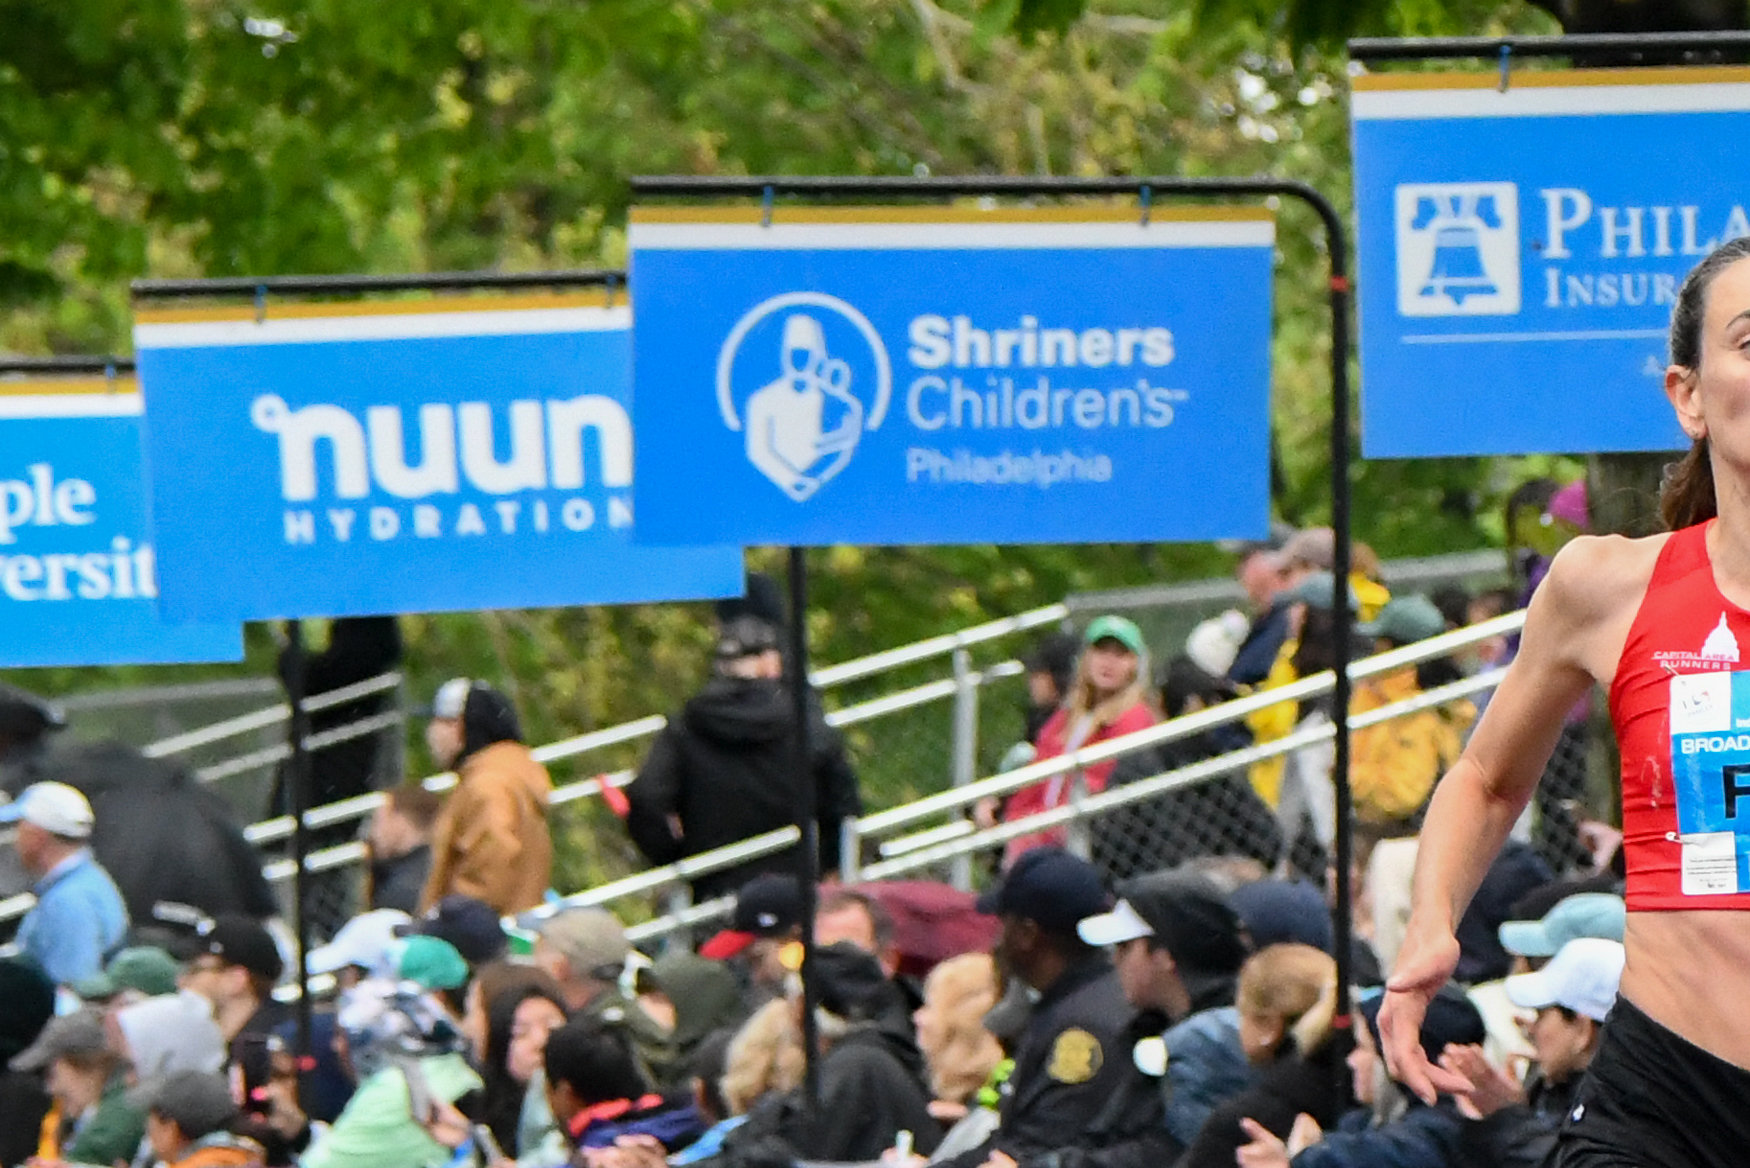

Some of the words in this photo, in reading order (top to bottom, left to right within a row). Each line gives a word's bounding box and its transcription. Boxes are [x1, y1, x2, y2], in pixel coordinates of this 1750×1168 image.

[1543, 266, 1678, 307] INSUR
[907, 313, 1177, 371] Shriners
[249, 392, 632, 502] nuun
[905, 444, 1113, 490] Philadelphia
[283, 495, 632, 545] HYDRATION
[0, 534, 159, 601] ersit
[1660, 660, 1731, 670] RUNNERS
